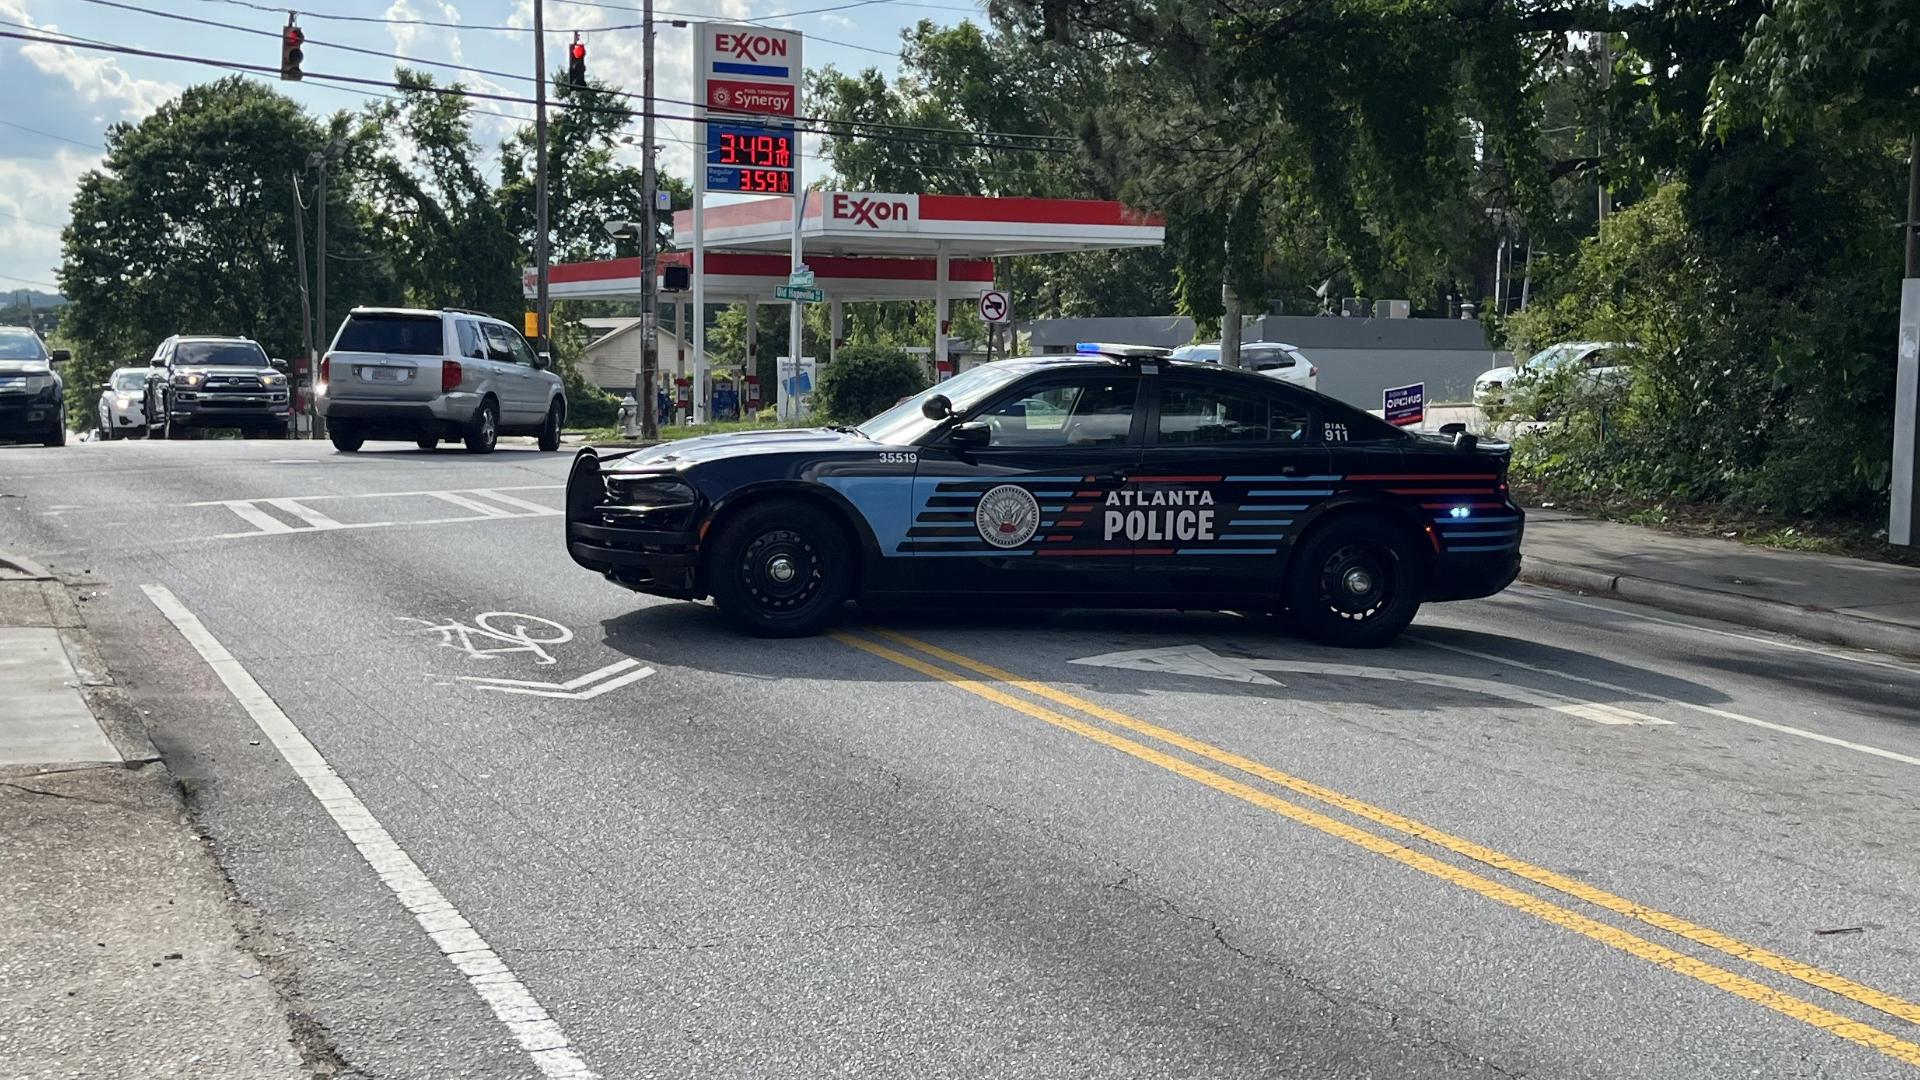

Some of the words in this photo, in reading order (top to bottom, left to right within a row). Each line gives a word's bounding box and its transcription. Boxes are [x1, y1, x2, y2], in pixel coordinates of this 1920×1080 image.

[715, 33, 787, 62] EXXON
[735, 91, 790, 111] Synergy
[721, 133, 772, 166] 3.49
[740, 169, 777, 192] 3.59
[776, 286, 787, 298] Old
[1324, 422, 1347, 430] DIAL
[1325, 430, 1348, 441] 911
[879, 452, 917, 464] 35519
[1105, 490, 1215, 506] ATLANTA
[1104, 510, 1215, 541] POLICE
